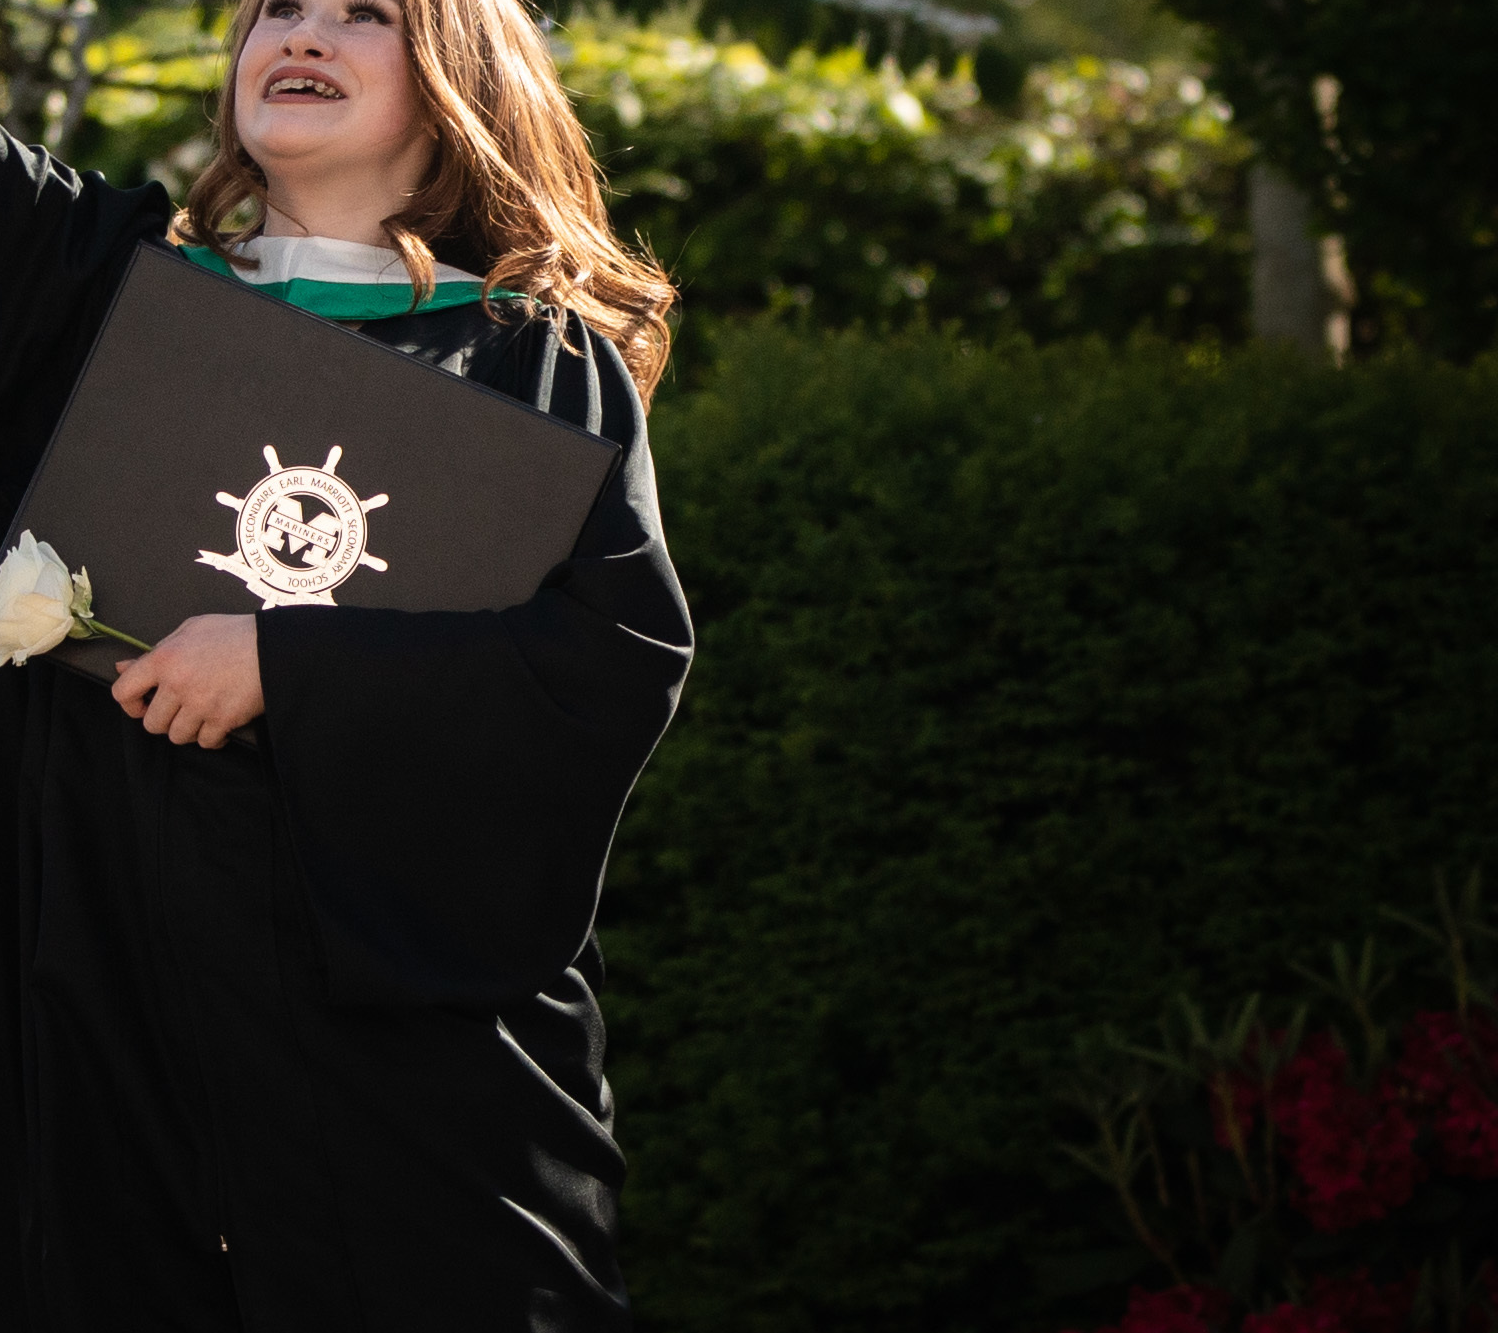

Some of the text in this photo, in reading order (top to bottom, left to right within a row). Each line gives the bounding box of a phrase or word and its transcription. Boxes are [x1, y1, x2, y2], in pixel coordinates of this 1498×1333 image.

[279, 476, 305, 489] EARL
[310, 477, 354, 514] MARRIOTT
[245, 485, 277, 544] SECONDAIRE
[274, 517, 330, 546] MARINERS
[331, 518, 358, 576] SECONDARY
[287, 572, 329, 588] SCHOOL
